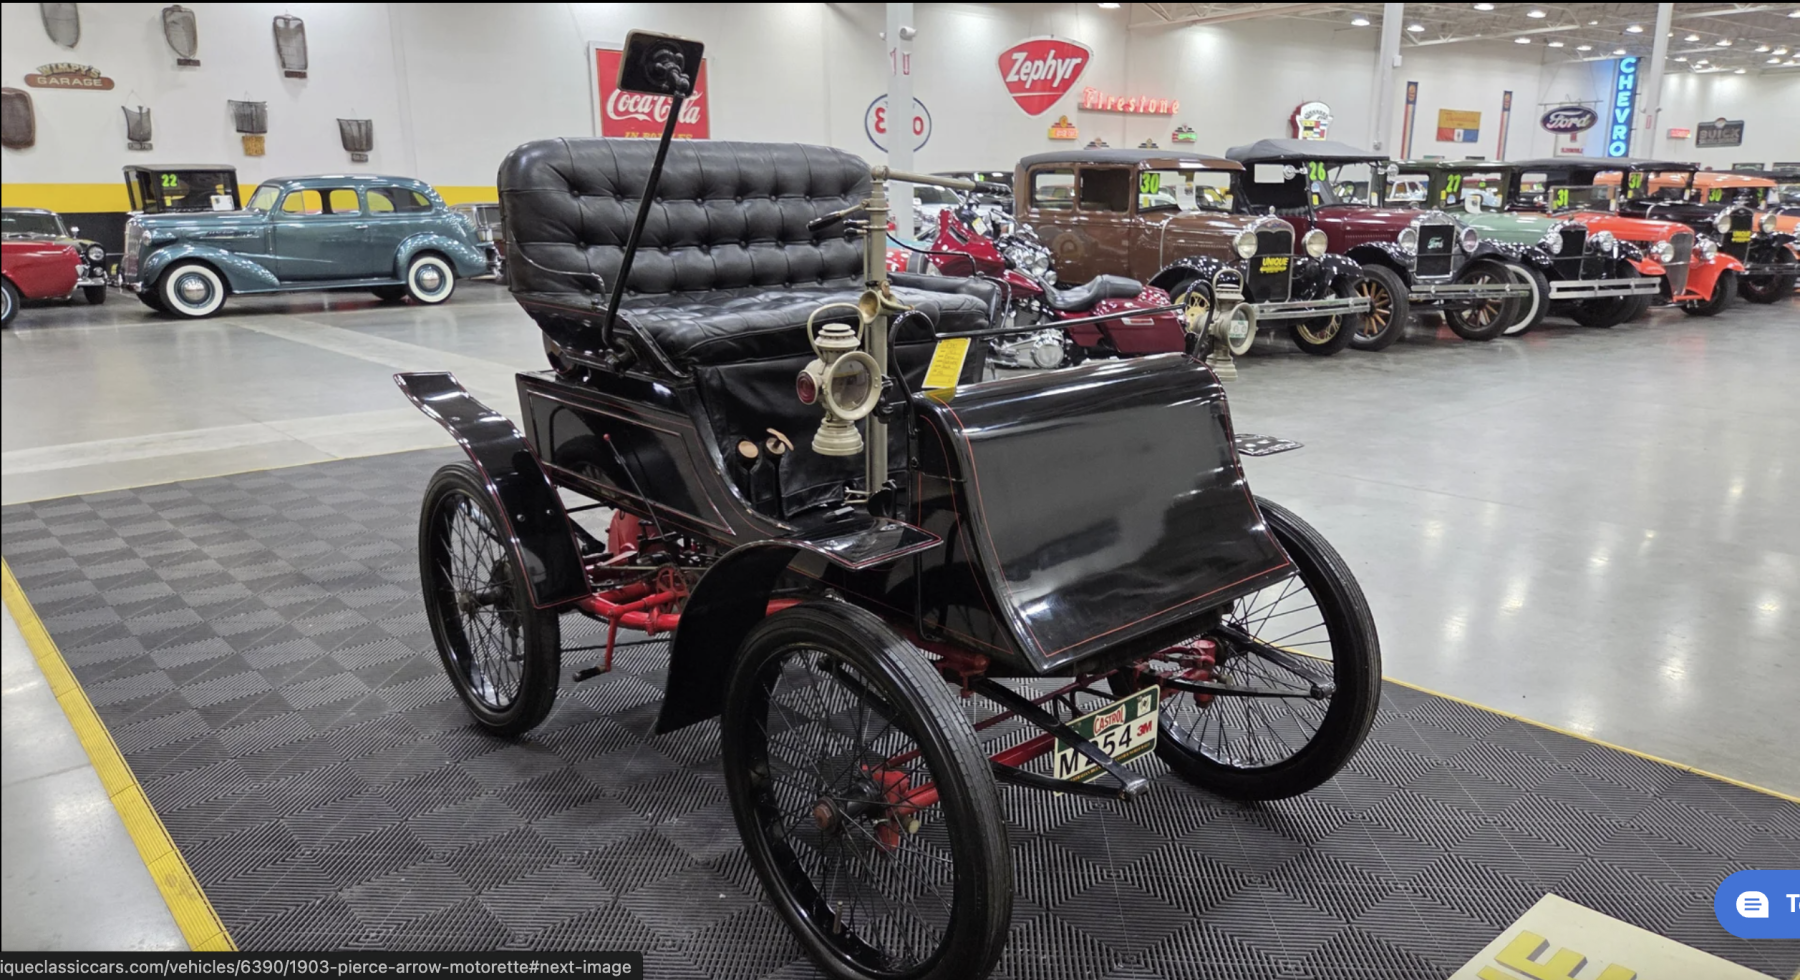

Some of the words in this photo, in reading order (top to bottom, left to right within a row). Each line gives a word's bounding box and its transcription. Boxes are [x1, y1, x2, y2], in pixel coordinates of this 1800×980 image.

[36, 63, 101, 79] WIMPY'S
[1005, 49, 1082, 88] Zephyr
[37, 76, 102, 87] GARAGE
[606, 88, 703, 124] Coca-Cla
[1082, 86, 1180, 114] Firestone
[1609, 57, 1637, 157] CHEVRO
[1546, 110, 1593, 129] Ford
[1699, 128, 1740, 139] BUICK
[161, 174, 178, 187] 22
[1309, 161, 1326, 181] 26
[1140, 173, 1160, 194] 30
[1446, 174, 1461, 193] 27
[1557, 189, 1569, 207] 31
[1262, 257, 1289, 266] UNIQUE
[1093, 707, 1125, 735] CASTROL
[1136, 720, 1152, 737] 3M
